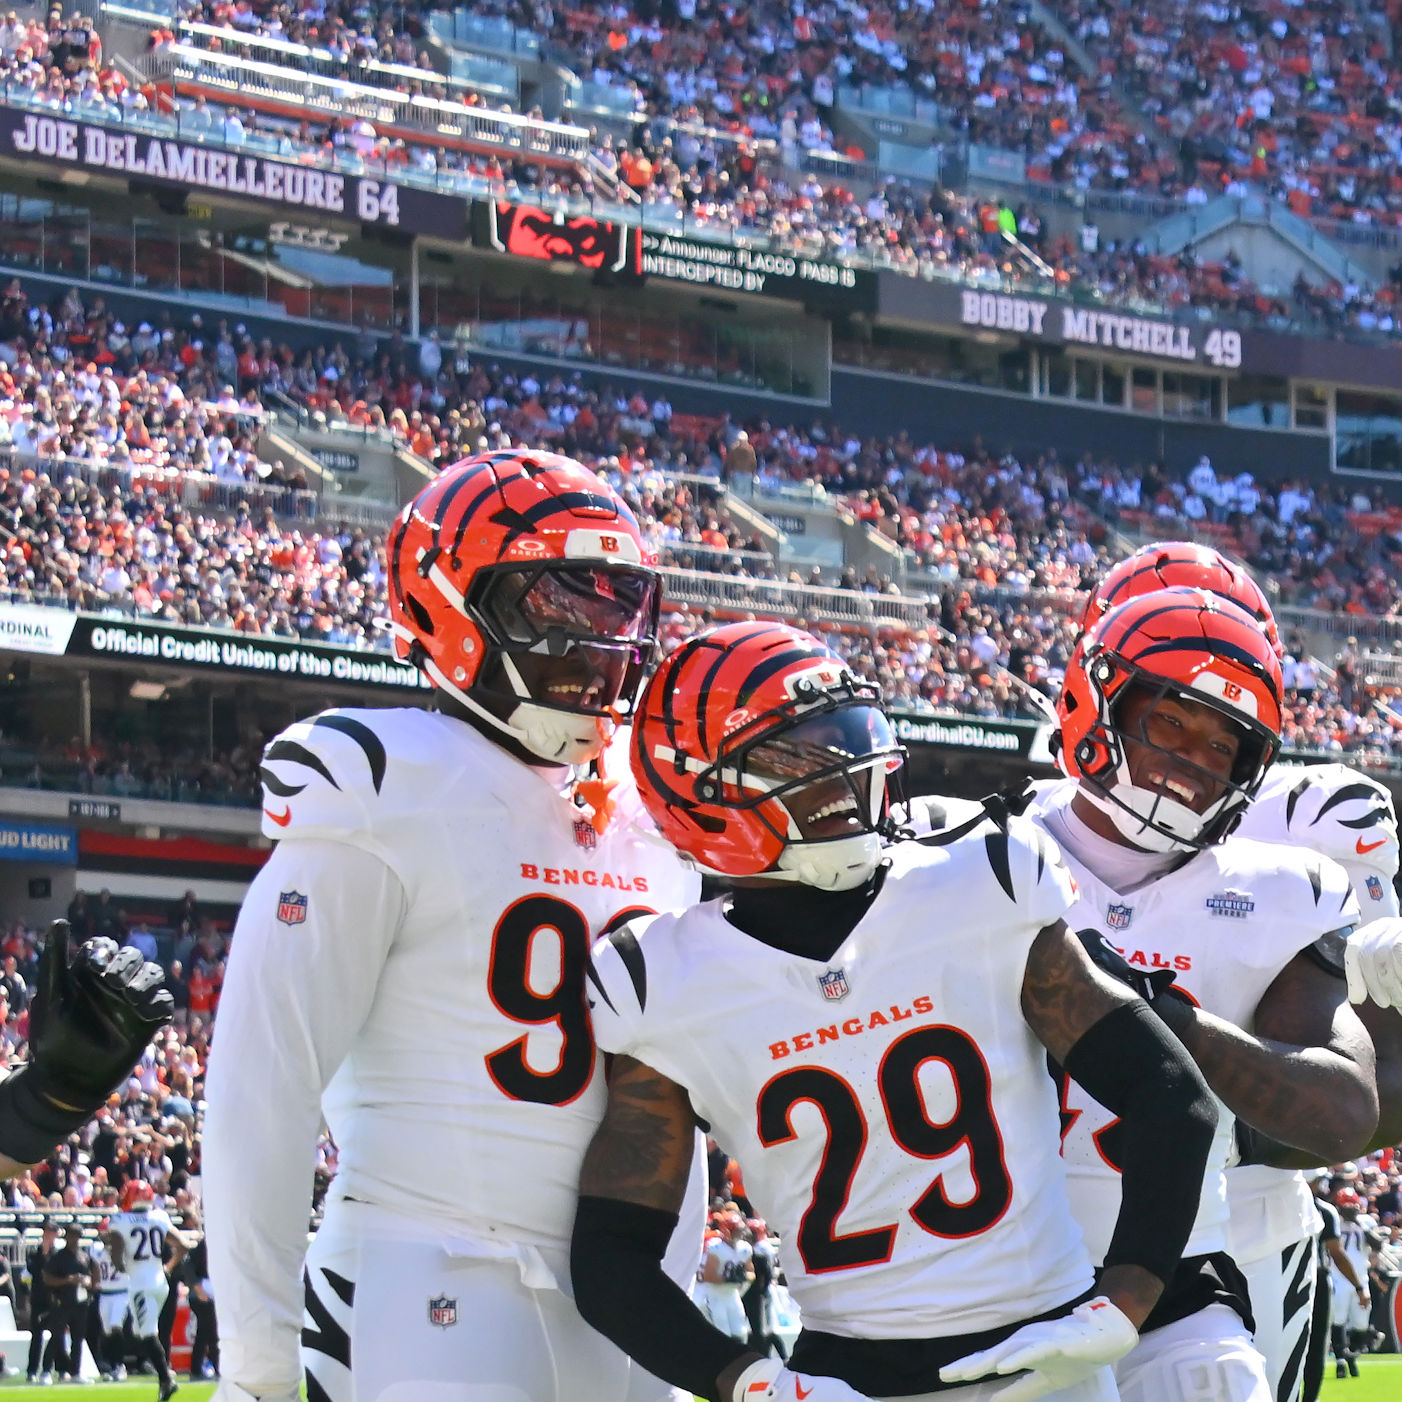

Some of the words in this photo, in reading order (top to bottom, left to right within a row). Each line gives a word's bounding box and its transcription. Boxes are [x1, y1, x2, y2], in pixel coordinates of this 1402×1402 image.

[13, 114, 78, 160] JOE
[358, 179, 400, 226] 64
[643, 256, 742, 288] INTERCEPTED
[743, 273, 766, 292] BY
[801, 262, 839, 285] PASS
[961, 290, 1048, 335] BOBBY
[1062, 307, 1196, 360] MITCHELL
[1204, 329, 1242, 368] 49
[91, 627, 159, 657] Official
[162, 637, 221, 664] Credit
[222, 645, 277, 670] Union
[277, 649, 301, 673] of
[300, 652, 332, 678] the
[331, 656, 418, 688] Cleveland
[900, 717, 1020, 751] CardinalCU.com
[21, 833, 70, 851] LIGHT
[520, 862, 649, 893] BENGALS
[484, 892, 661, 1107] 9
[768, 996, 934, 1062] BENGALS
[756, 1022, 1013, 1275] 29
[130, 1225, 164, 1261] 20
